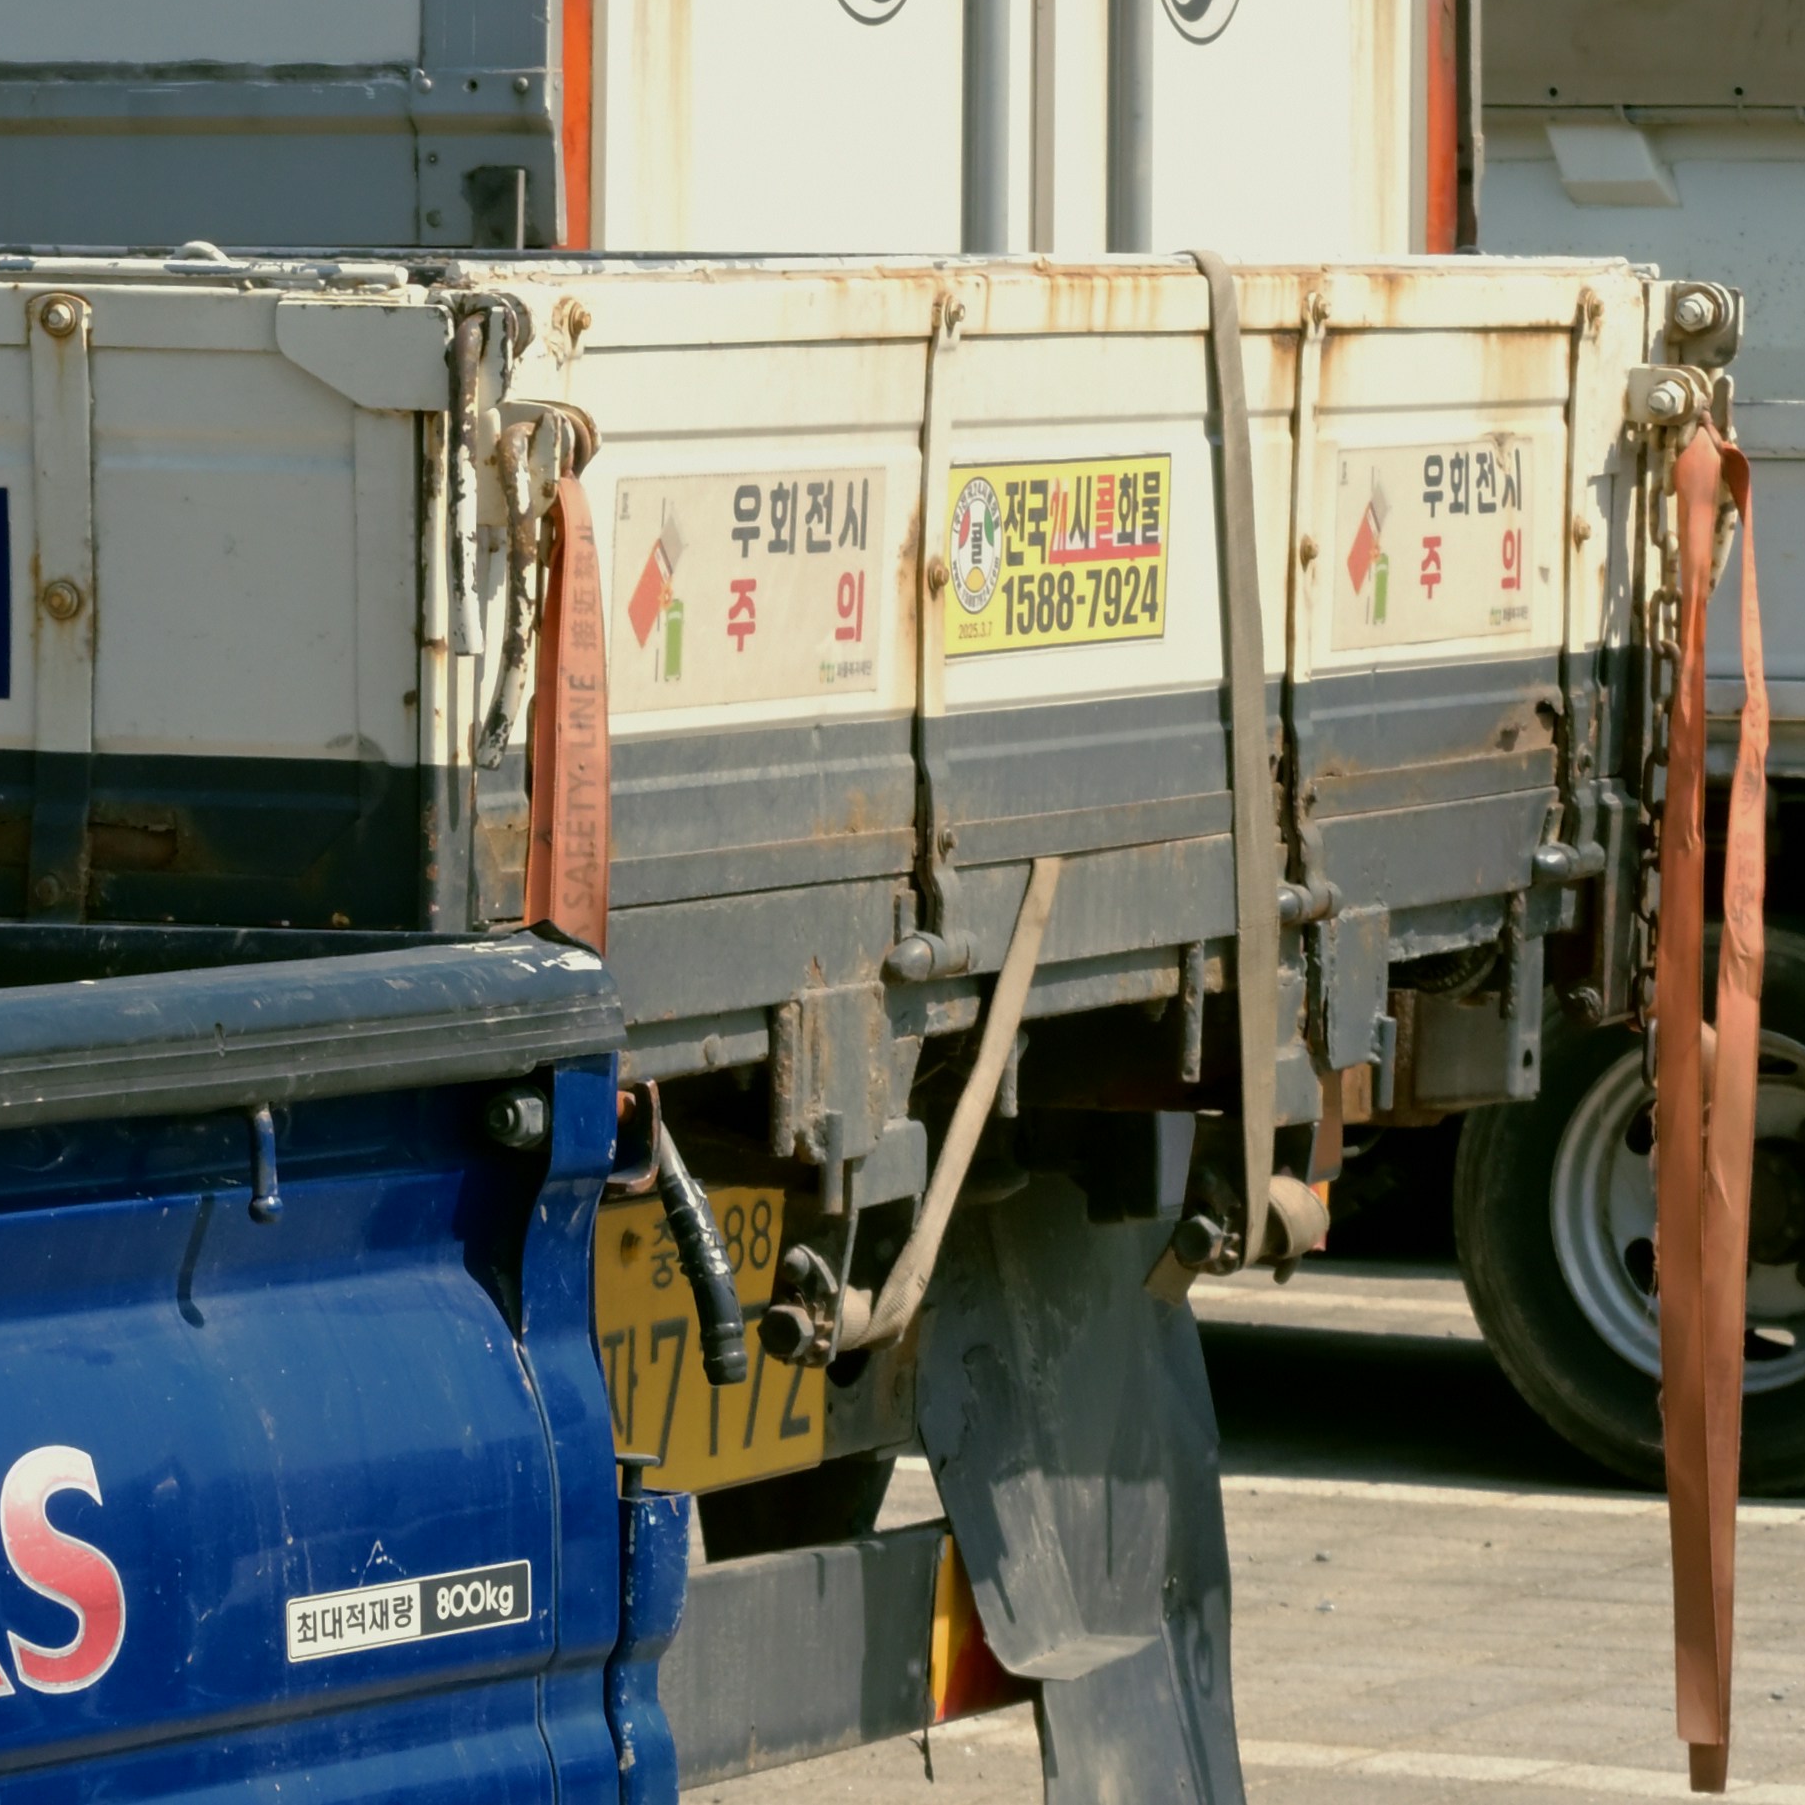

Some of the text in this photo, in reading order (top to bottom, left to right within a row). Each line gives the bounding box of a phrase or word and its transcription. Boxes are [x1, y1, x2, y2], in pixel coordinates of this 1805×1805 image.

[730, 477, 869, 559] 우회전시
[1422, 448, 1522, 519] 우회전시
[726, 569, 865, 653] 주 의
[1001, 564, 1159, 637] 1588-7924
[568, 673, 596, 747] LINE
[563, 771, 597, 910] SAFETY
[296, 1579, 515, 1644] 최대적재량 800kg
